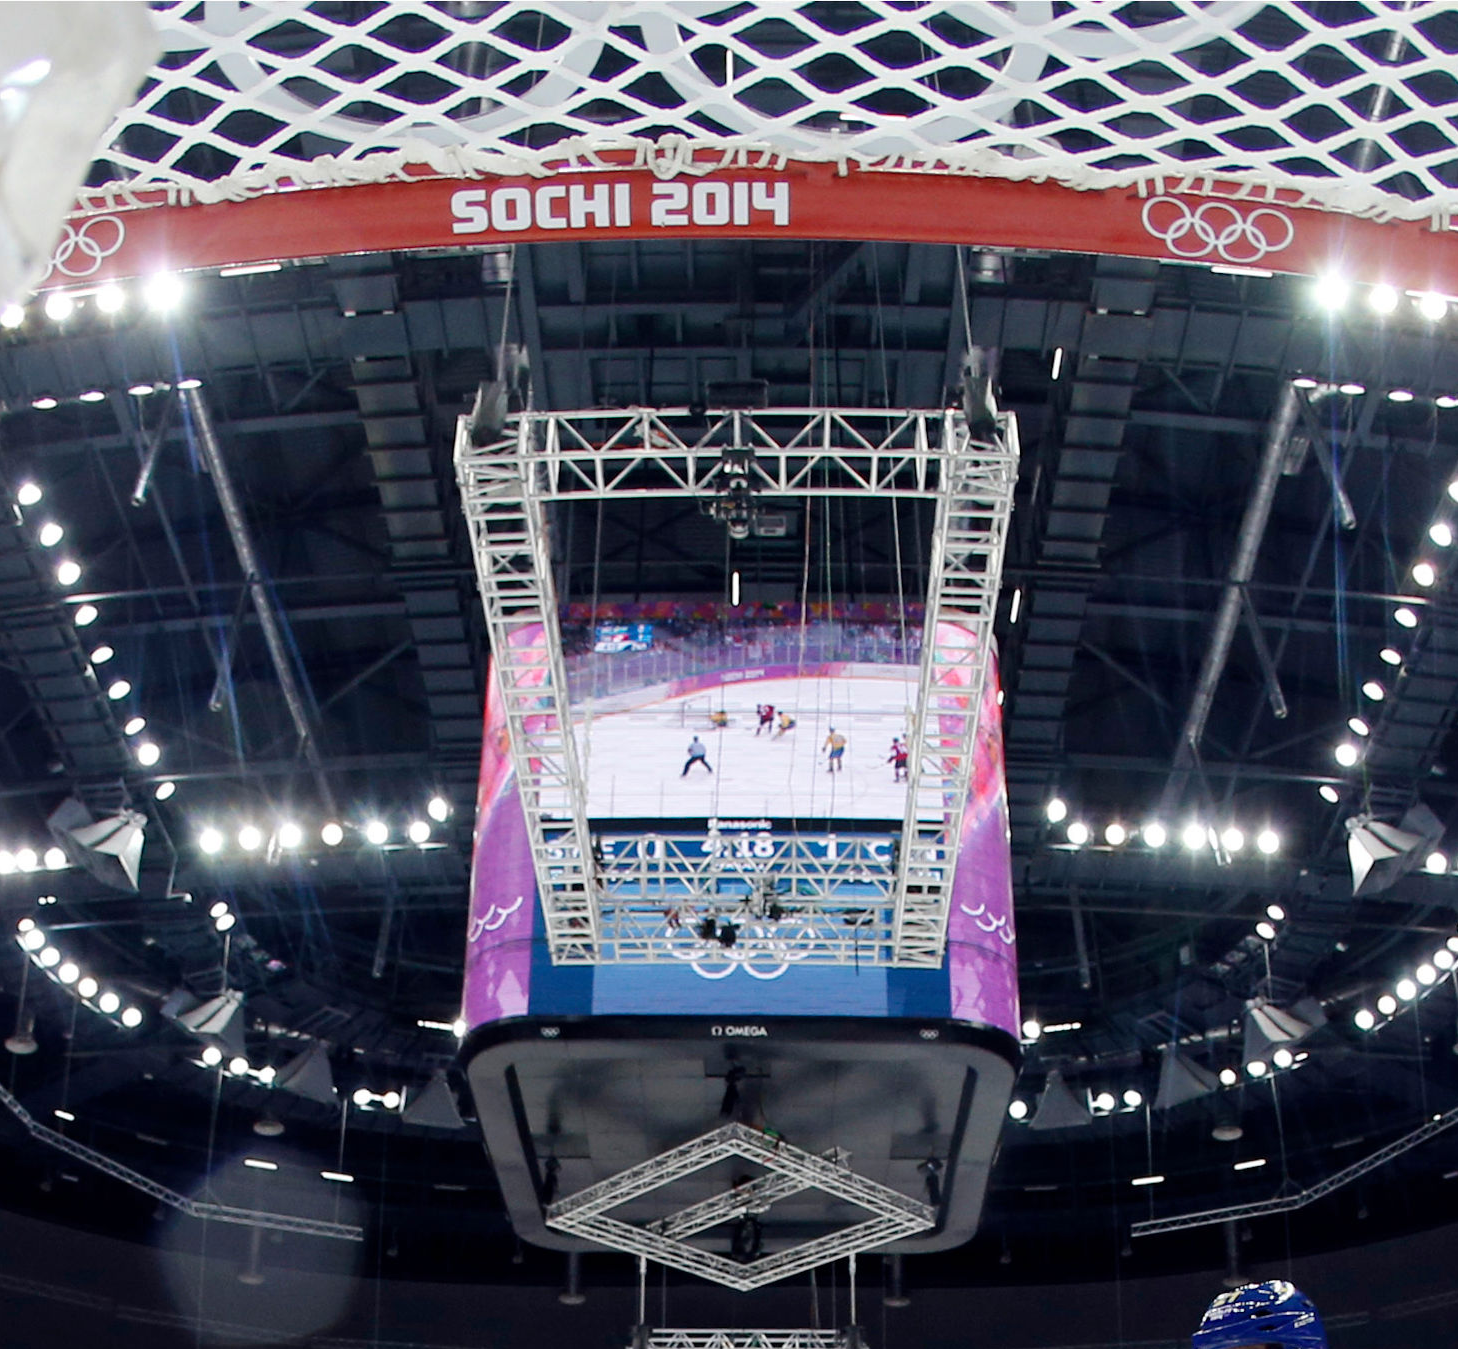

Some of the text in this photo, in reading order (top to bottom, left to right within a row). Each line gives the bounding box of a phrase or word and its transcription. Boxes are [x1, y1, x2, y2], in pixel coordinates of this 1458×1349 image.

[451, 181, 790, 234] SOCHI 2014
[725, 1025, 768, 1037] OMEGA
